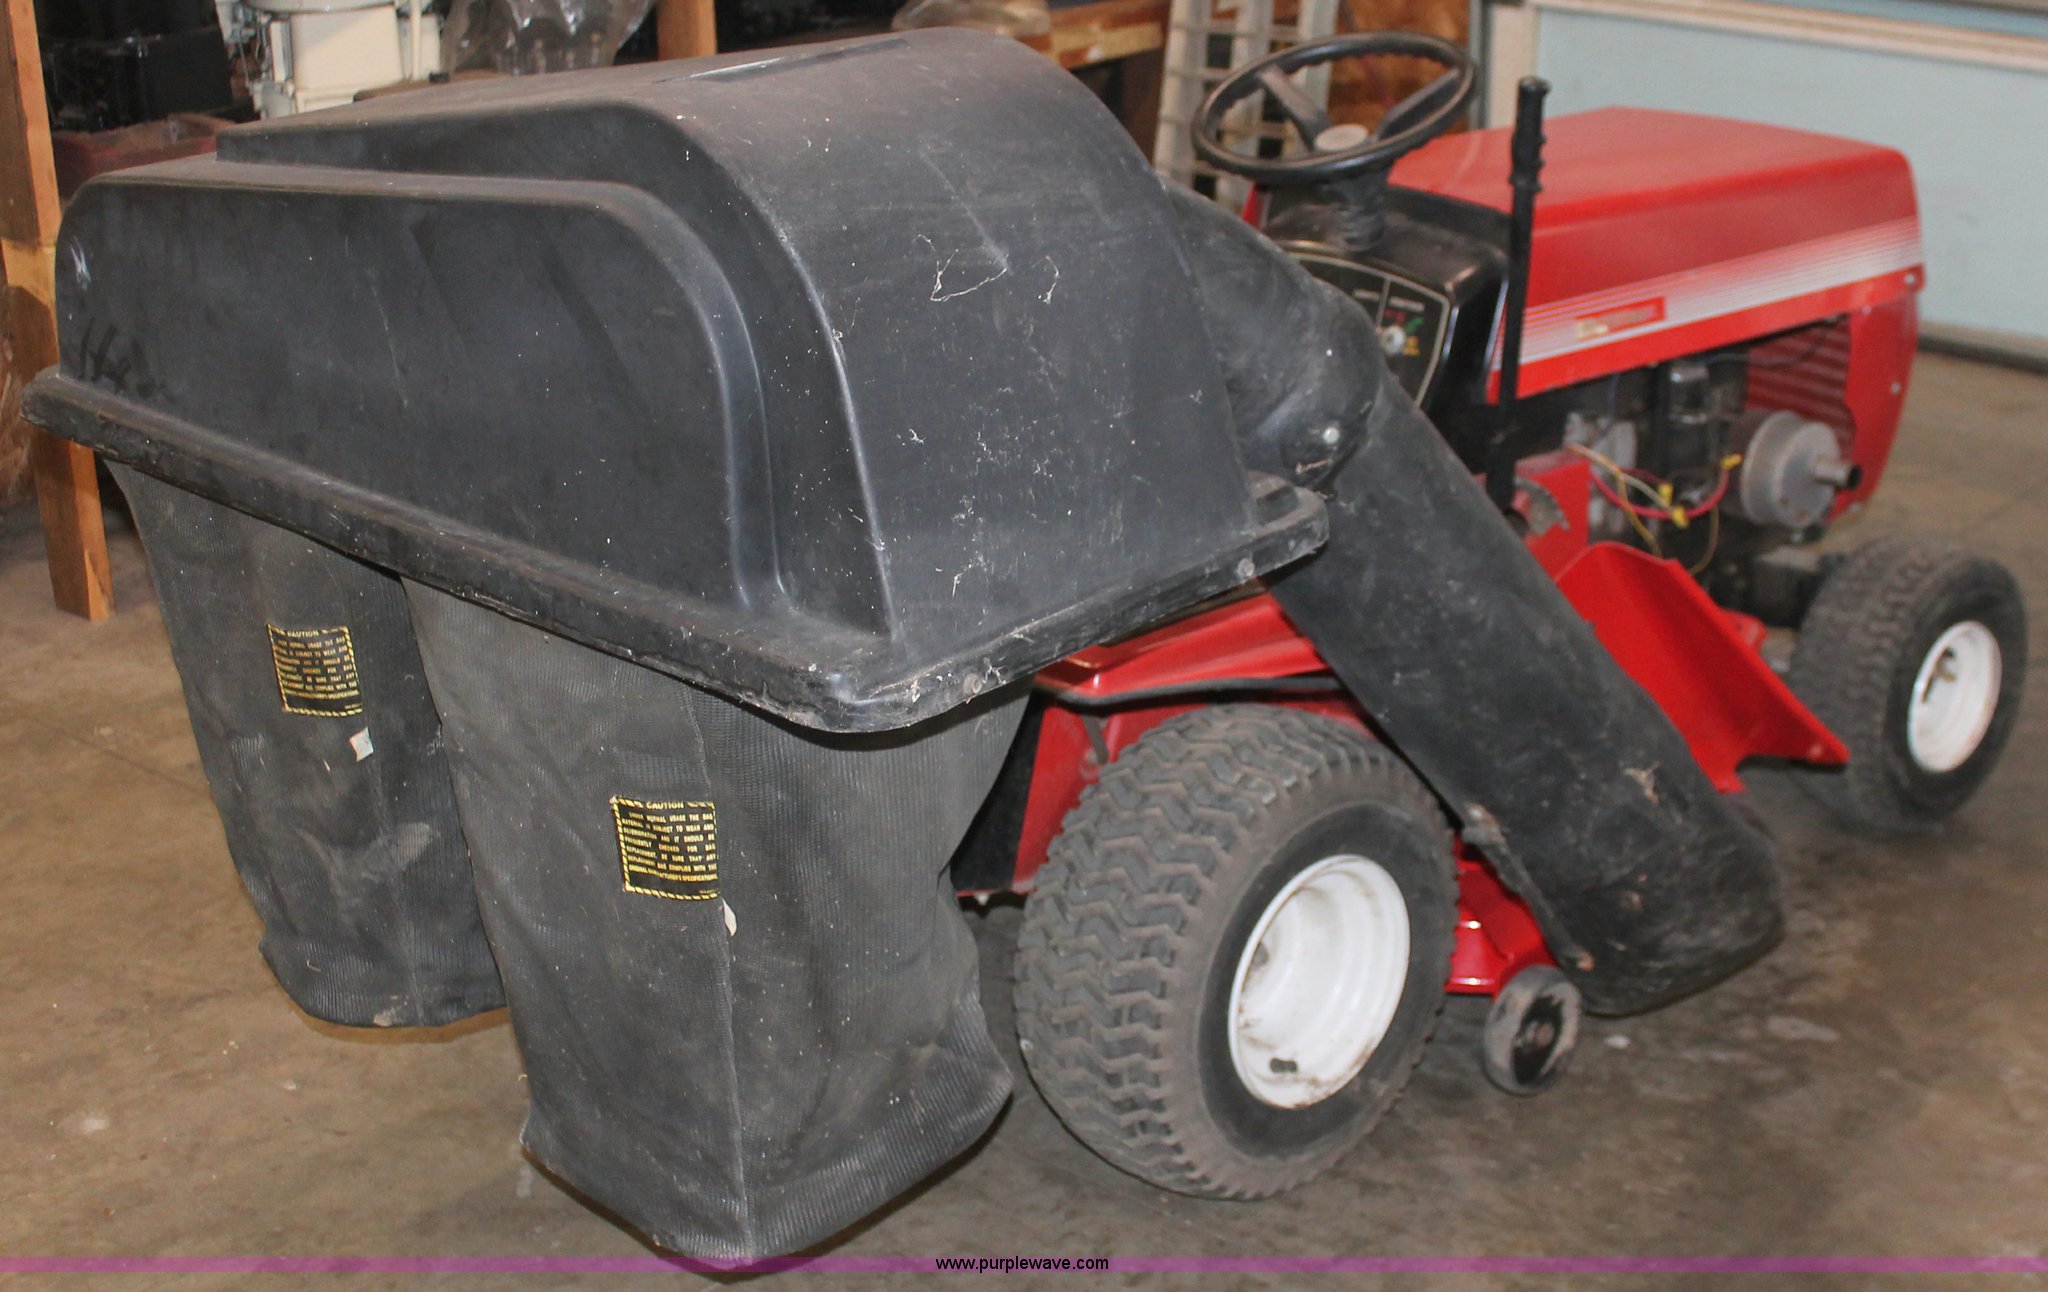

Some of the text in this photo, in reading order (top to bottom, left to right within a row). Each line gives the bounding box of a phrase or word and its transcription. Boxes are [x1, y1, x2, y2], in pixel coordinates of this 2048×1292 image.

[646, 801, 684, 810] CAUTION
[647, 814, 666, 823] NORMAL
[669, 814, 686, 822] USAGE
[689, 813, 699, 821] THE
[686, 824, 700, 832] WEAR
[703, 823, 714, 831] AND
[674, 835, 679, 843] IT
[684, 834, 704, 842] SHOULD
[708, 833, 715, 841] BE
[659, 843, 680, 852] CHECKED
[705, 843, 715, 851] BAG
[672, 854, 684, 862] SURE
[706, 853, 716, 861] ANY
[693, 864, 706, 872] WITH
